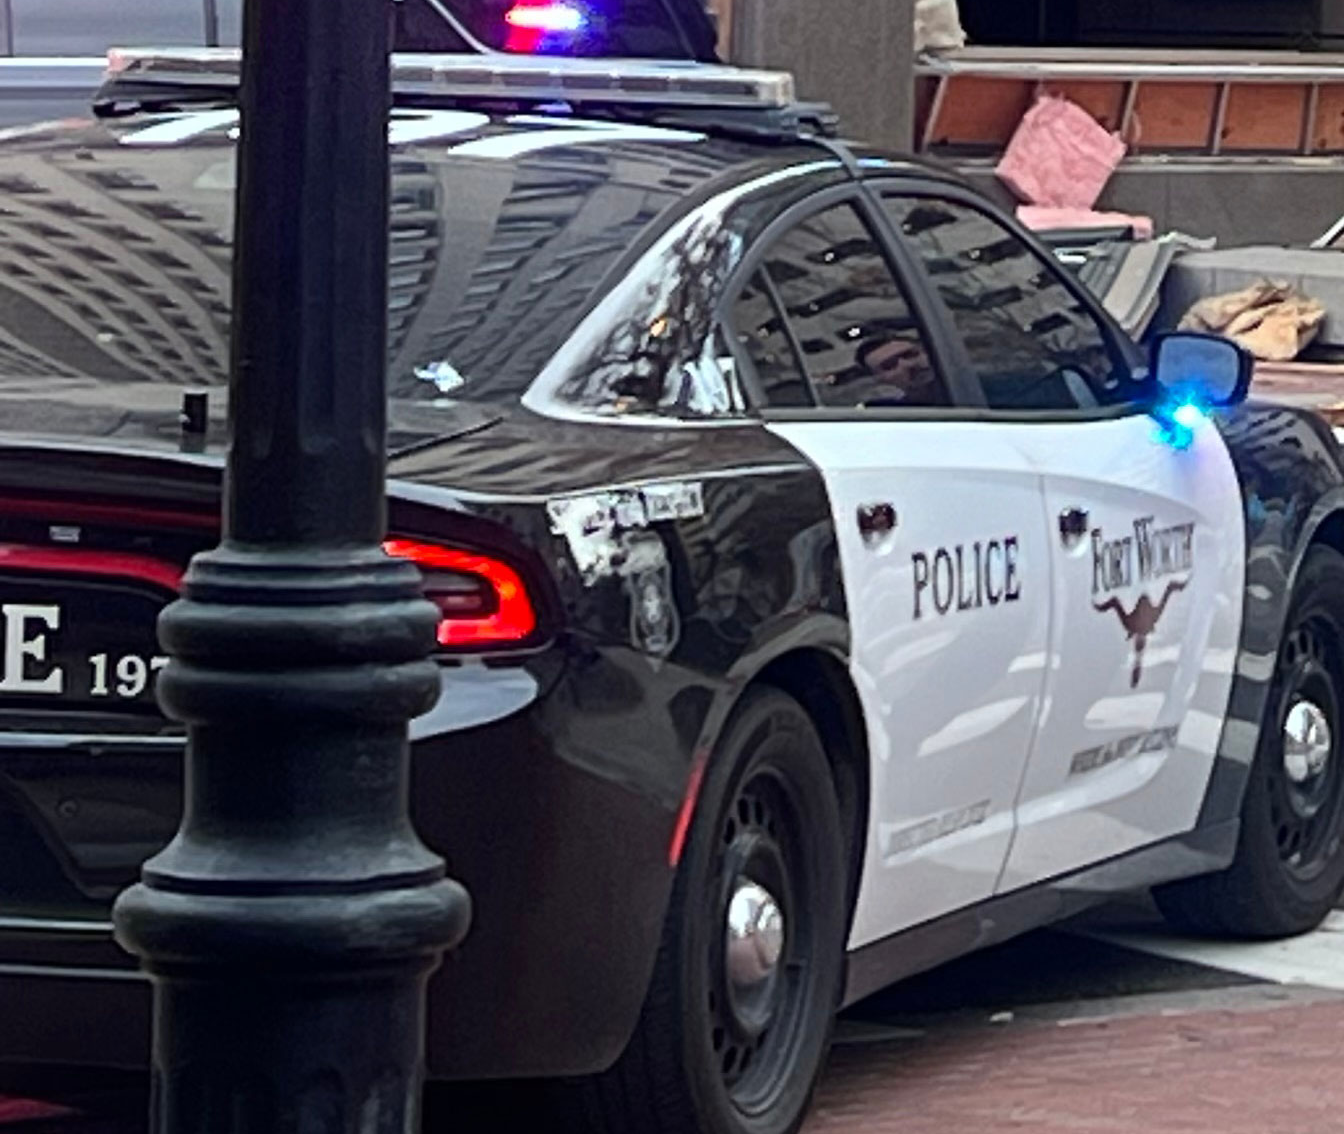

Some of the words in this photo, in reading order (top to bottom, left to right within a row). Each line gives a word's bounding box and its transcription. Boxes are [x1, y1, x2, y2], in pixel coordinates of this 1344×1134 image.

[911, 536, 1021, 621] POLICE
[1091, 527, 1132, 595] FORT
[88, 652, 172, 698] 19
